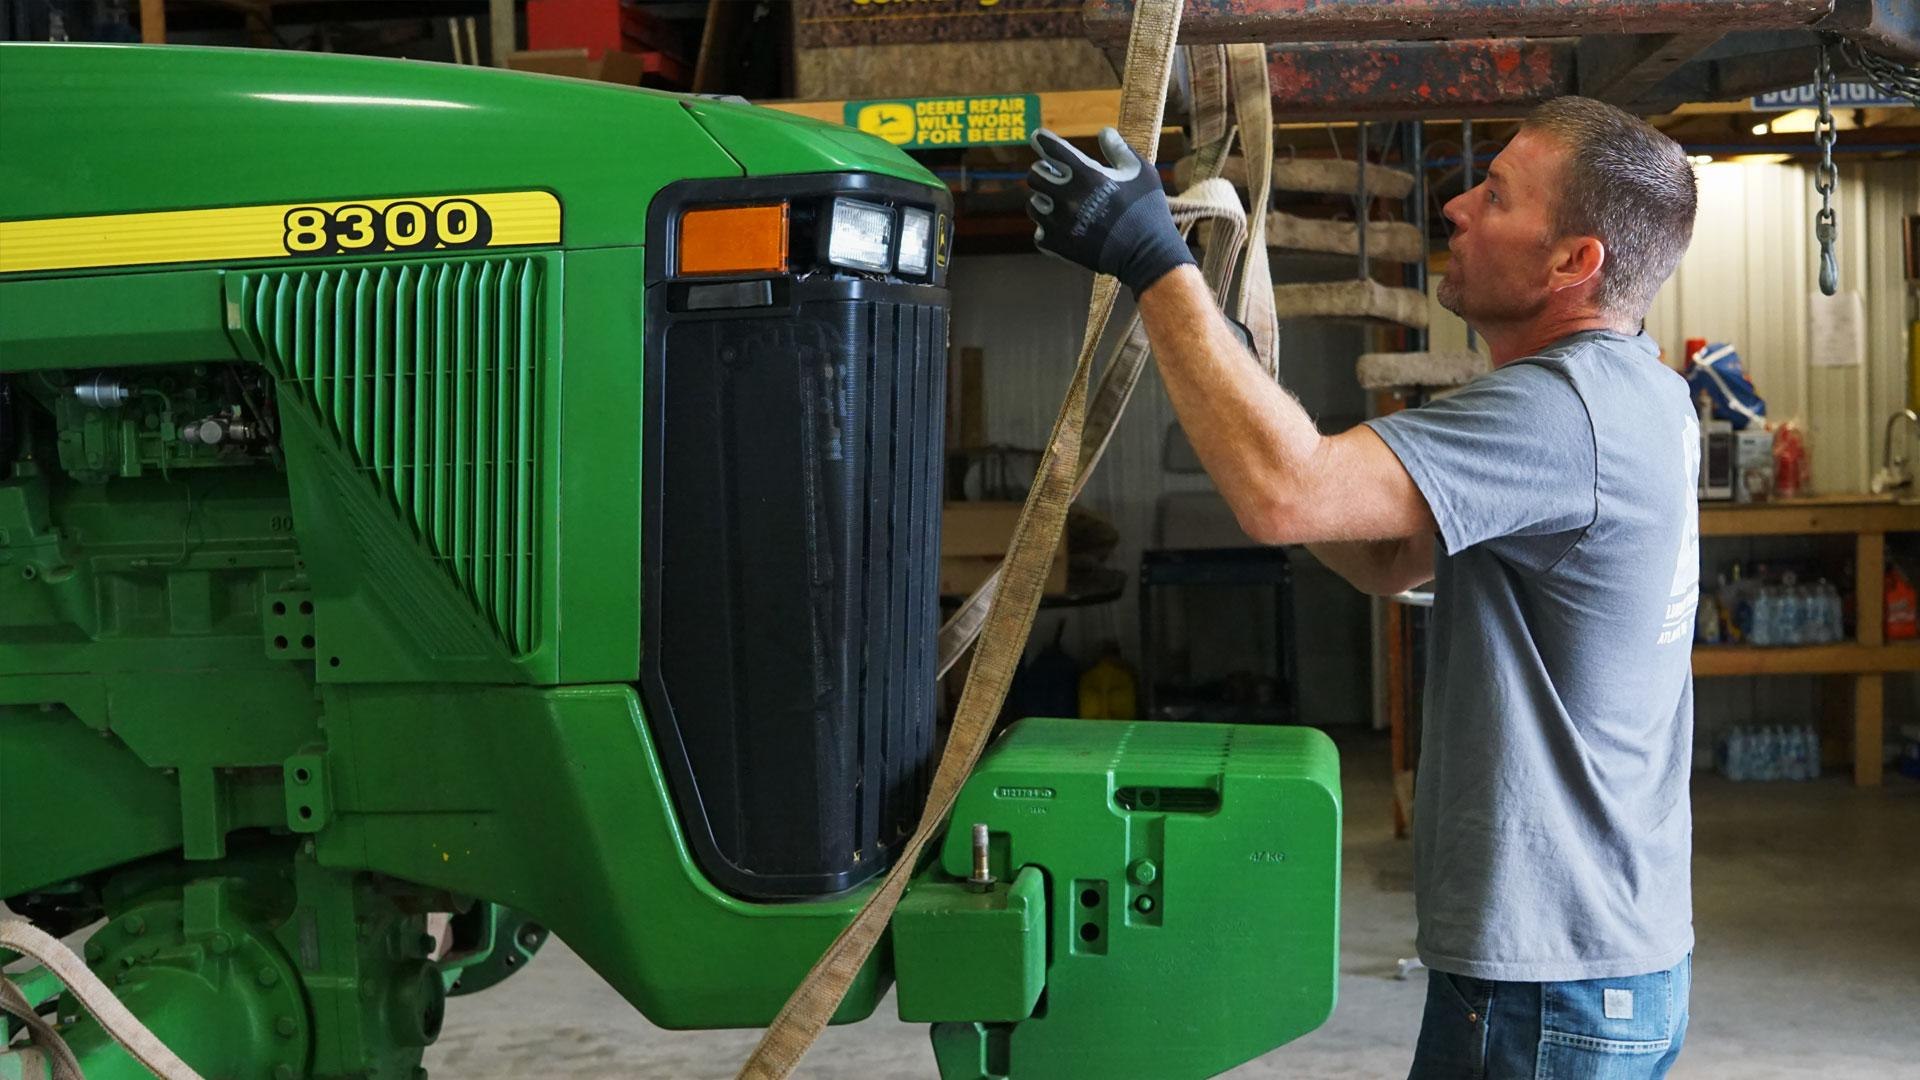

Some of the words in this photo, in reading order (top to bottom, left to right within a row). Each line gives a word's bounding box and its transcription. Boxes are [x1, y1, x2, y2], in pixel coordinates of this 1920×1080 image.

[1829, 82, 1890, 100] LIGH
[916, 101, 966, 116] DEERE
[969, 98, 1025, 113] REPAIR
[917, 115, 963, 130] WILL
[968, 113, 1025, 128] WORK
[917, 129, 962, 144] FOR
[967, 127, 1026, 142] BEER
[284, 199, 480, 253] 8300
